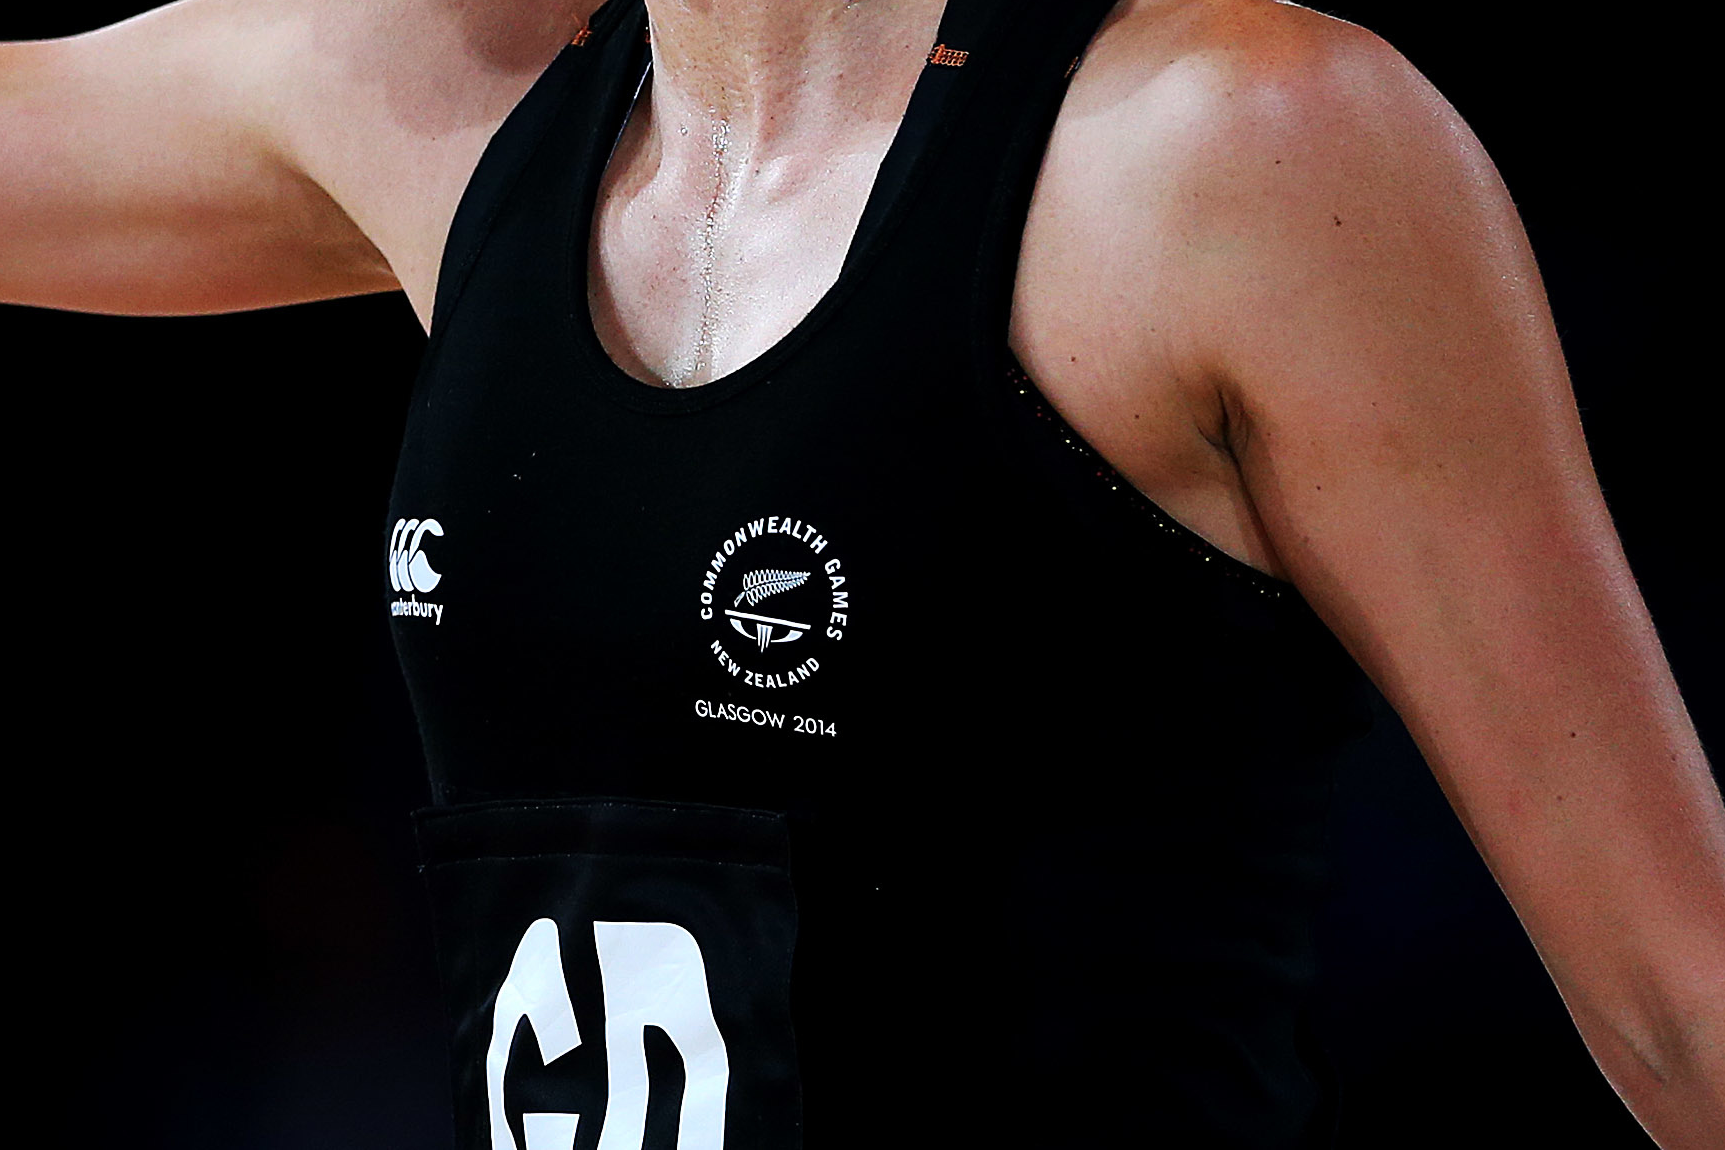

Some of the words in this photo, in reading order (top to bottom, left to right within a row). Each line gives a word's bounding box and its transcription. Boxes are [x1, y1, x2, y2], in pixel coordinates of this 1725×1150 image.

[700, 516, 829, 620] COMMONWEALTH
[825, 558, 849, 641] GAMES
[710, 640, 741, 677] NEW
[744, 657, 820, 688] ZEALAND
[695, 699, 786, 729] GLASGOW
[793, 716, 837, 737] 2014
[486, 917, 730, 1150] GD
